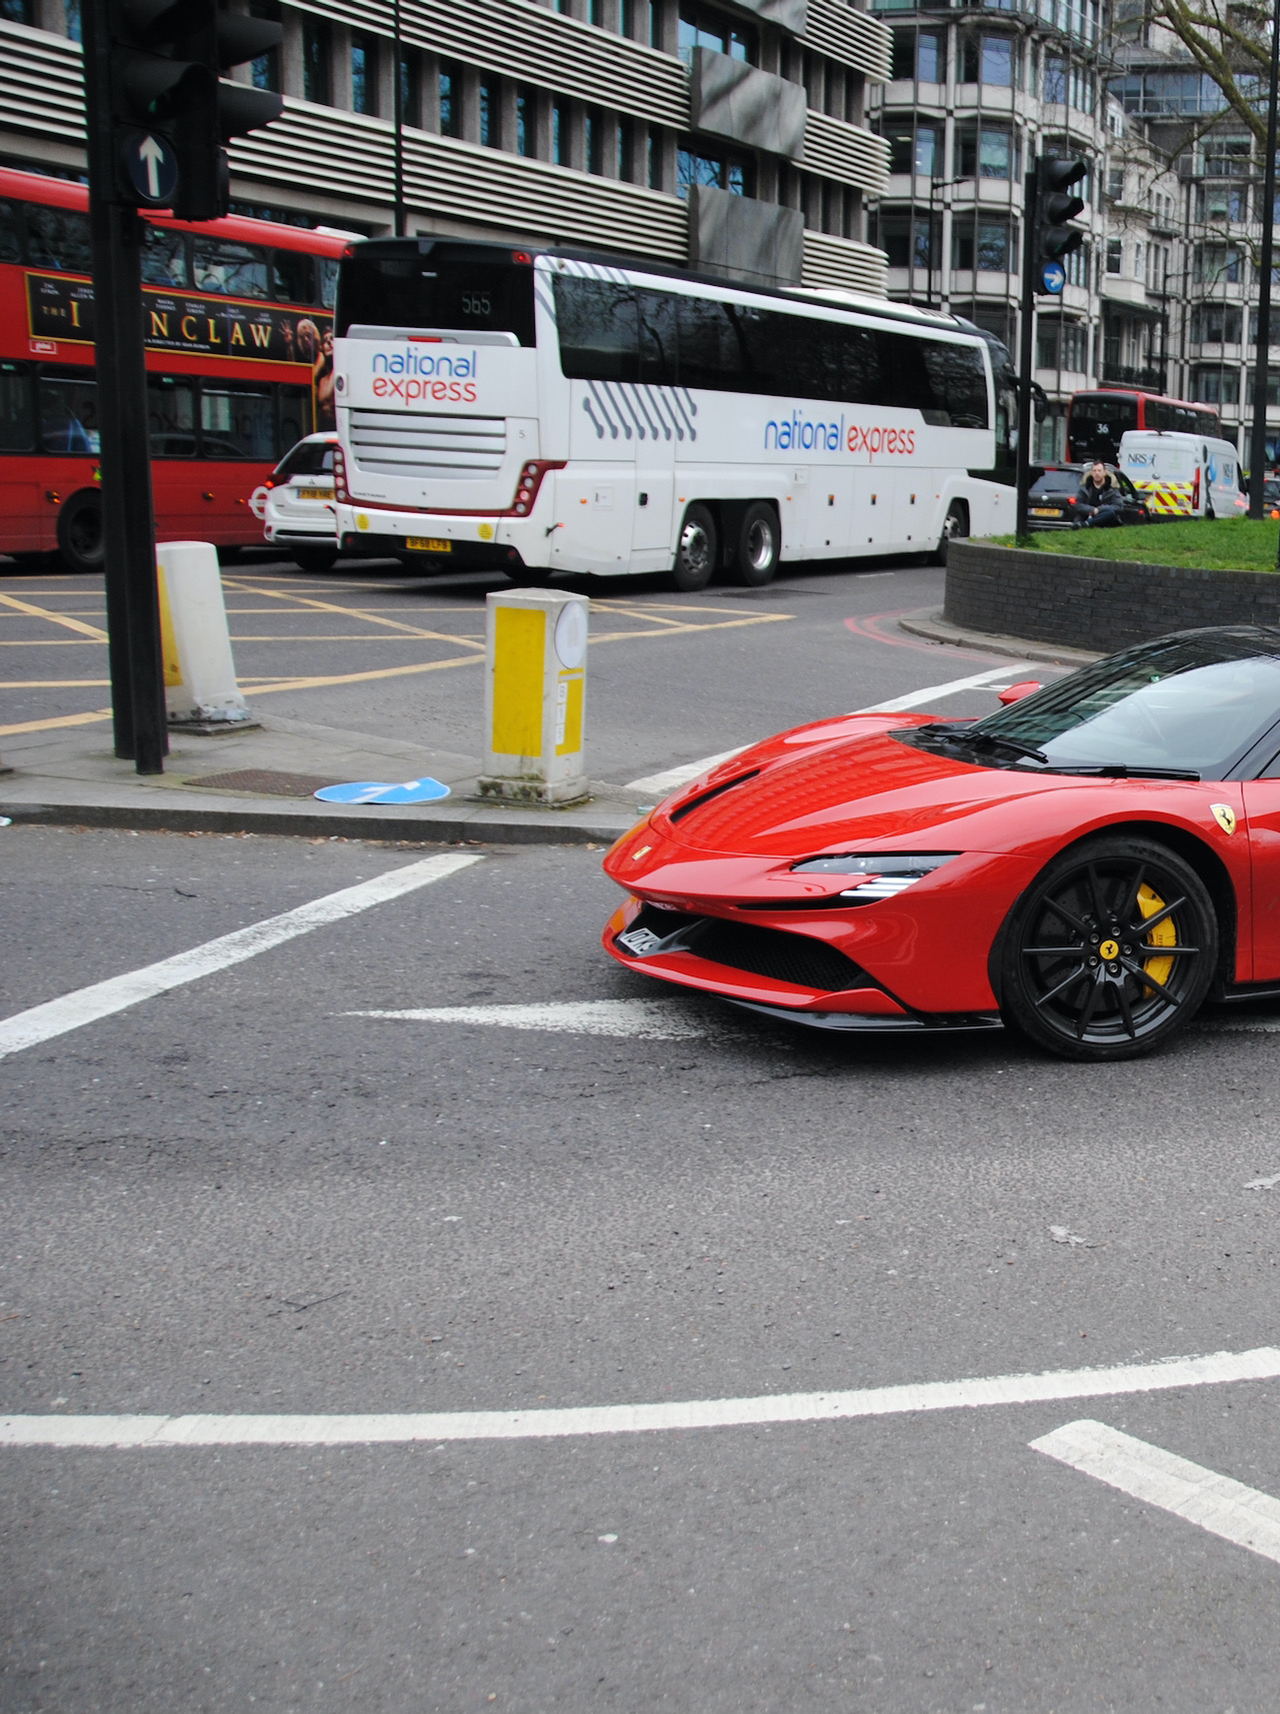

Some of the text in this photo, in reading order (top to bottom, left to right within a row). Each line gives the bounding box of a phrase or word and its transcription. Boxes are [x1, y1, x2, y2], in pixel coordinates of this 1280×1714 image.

[42, 305, 67, 317] THE
[181, 315, 272, 348] CLAW
[372, 347, 477, 378] national
[373, 377, 477, 406] express
[764, 409, 915, 463] national express
[1097, 423, 1109, 434] 36
[1128, 453, 1147, 464] NRS
